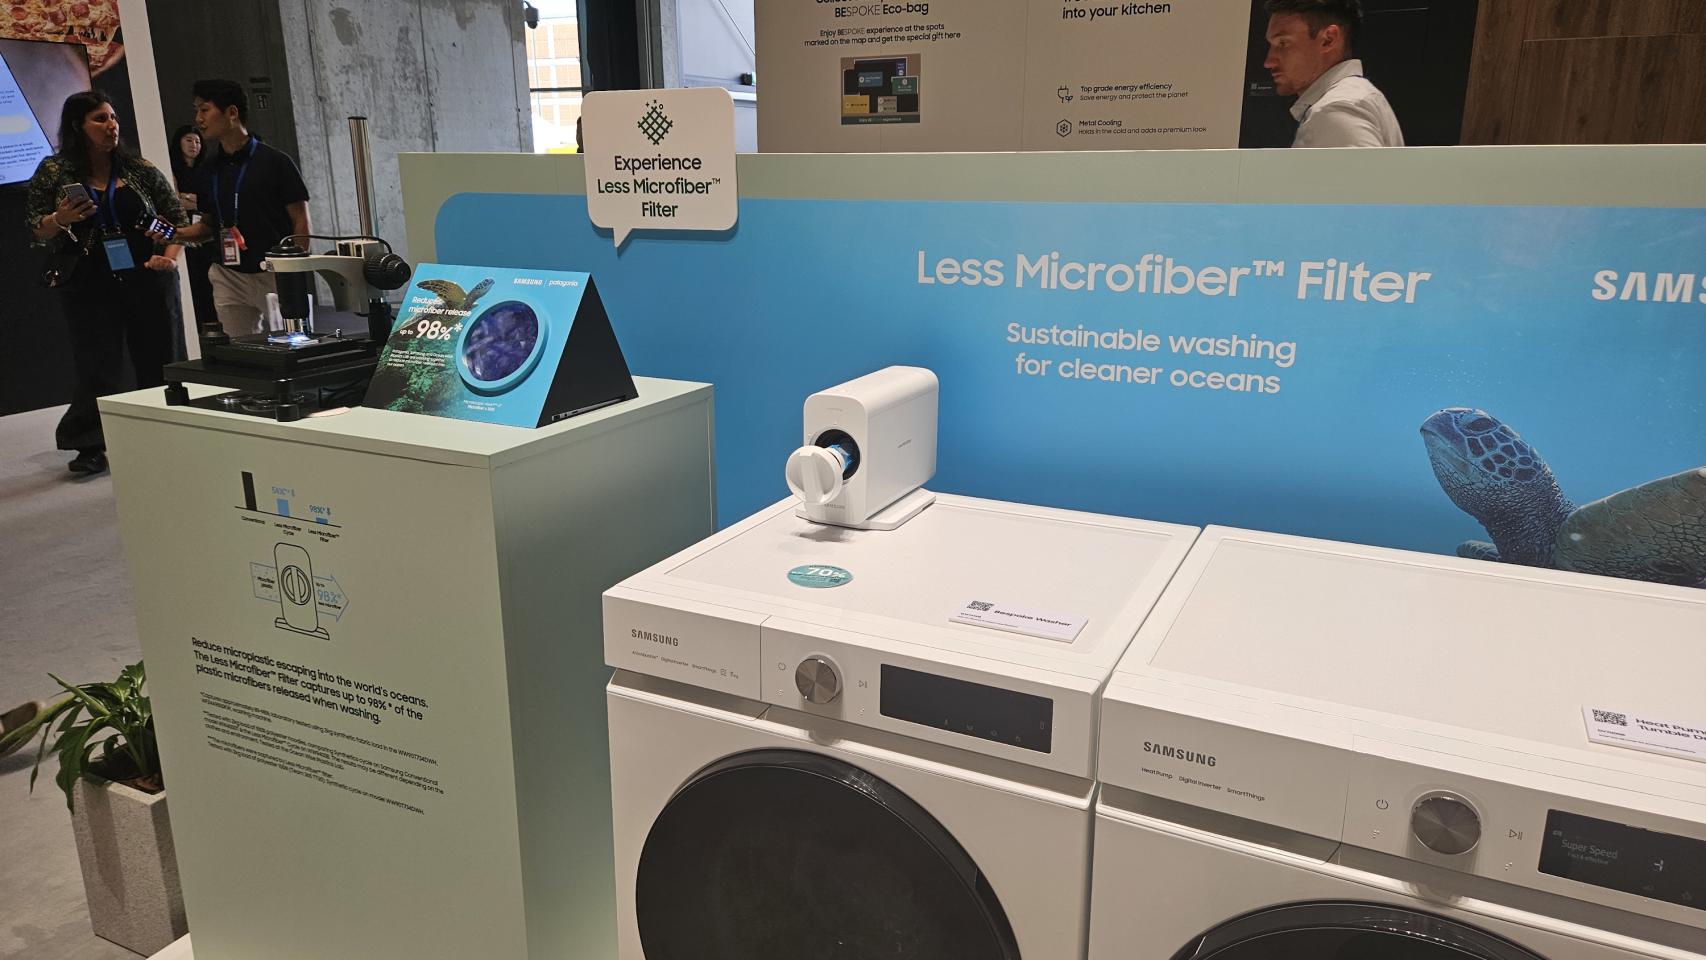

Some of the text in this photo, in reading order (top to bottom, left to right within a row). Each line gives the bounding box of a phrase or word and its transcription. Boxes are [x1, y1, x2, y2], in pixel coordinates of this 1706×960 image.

[835, 2, 928, 18] BESPOKE Eco-bag
[1062, 2, 1171, 20] into your kitchen
[804, 38, 830, 46] marked
[852, 38, 866, 46] map
[882, 36, 893, 44] get
[907, 33, 930, 42] special
[932, 32, 944, 41] gift
[820, 29, 836, 38] Enjoy
[866, 26, 904, 34] experience
[926, 24, 944, 32] spots
[1093, 84, 1114, 94] grade
[1114, 84, 1138, 93] energy
[1139, 82, 1172, 91] efficiency
[1098, 119, 1122, 127] Cooling
[614, 154, 702, 175] Experience
[598, 176, 720, 194] Less Microfiber™
[642, 200, 678, 217] Filter
[917, 250, 1432, 304] Less Microfiber™ Filter
[1592, 270, 1706, 304] SAM
[408, 306, 472, 316] microfiber release
[1006, 321, 1297, 368] Sustainable washing
[1015, 352, 1282, 394] for cleaner oceans
[994, 610, 1034, 620] Bespoke
[1036, 616, 1072, 627] Washer
[631, 628, 679, 646] SAMSUNG
[192, 636, 428, 708] Reduce microplastic escaping into the world's oceans.
[194, 650, 209, 662] The
[210, 654, 228, 667] Less
[278, 672, 299, 686] Filter
[300, 680, 340, 698] captures
[342, 691, 354, 704] up
[356, 694, 366, 704] to
[394, 705, 404, 716] of
[406, 707, 423, 720] the
[196, 664, 382, 724] plastic microfibers released when washing.
[1636, 718, 1669, 729] Heat
[1639, 724, 1690, 738] Tumble
[1143, 741, 1217, 767] SAMSUNG
[1142, 766, 1266, 802] Heat Pump Digital Inverter SmartThings
[1561, 840, 1618, 860] Super Speed
